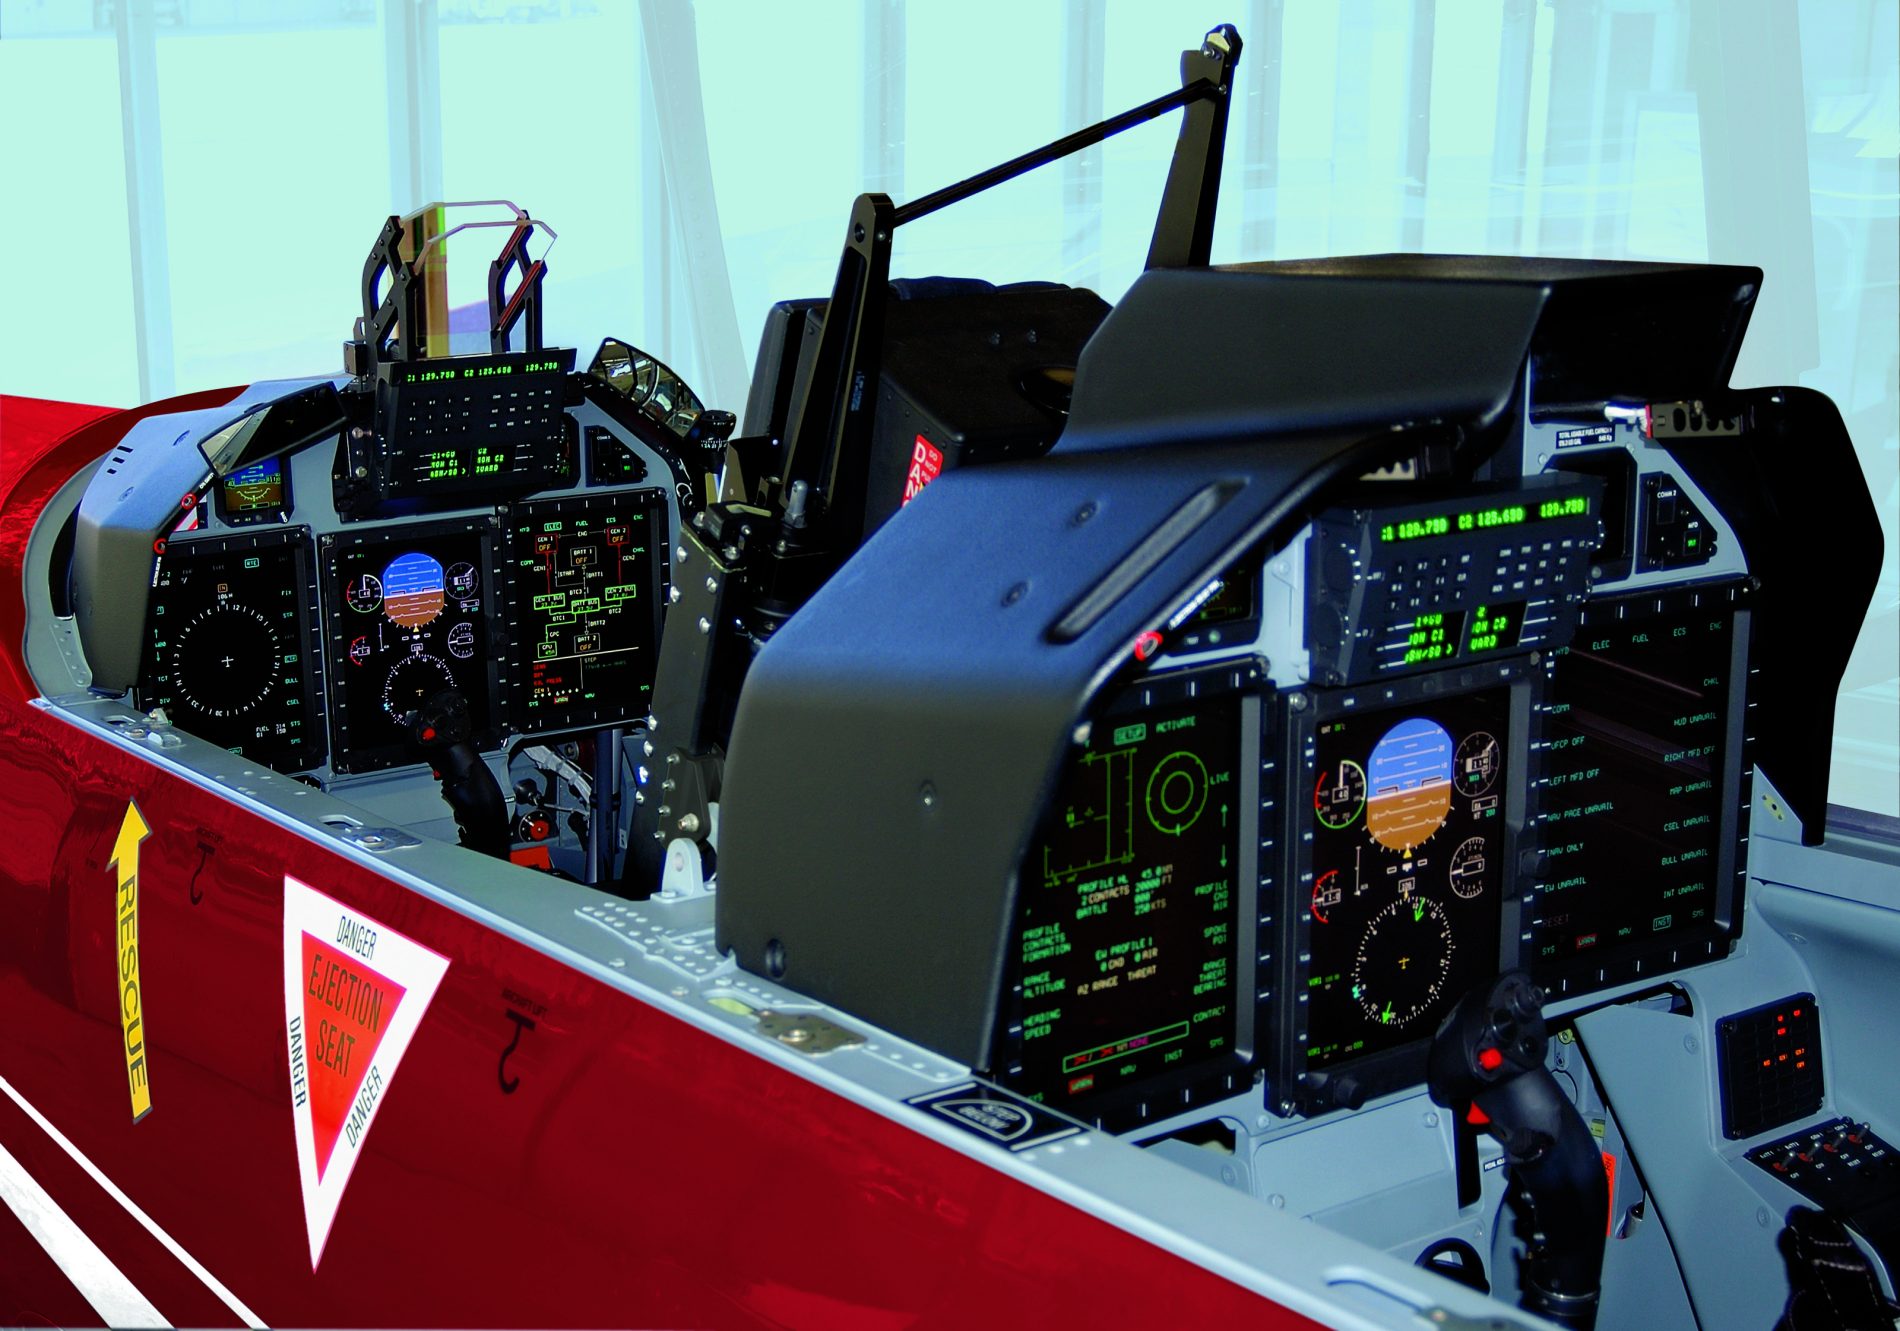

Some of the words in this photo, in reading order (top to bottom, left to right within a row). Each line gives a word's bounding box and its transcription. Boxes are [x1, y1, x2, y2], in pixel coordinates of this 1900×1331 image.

[1458, 513, 1474, 531] C2
[1592, 640, 1610, 651] ELEC
[1632, 634, 1648, 643] FUEL
[1673, 627, 1686, 637] ECS
[1552, 704, 1570, 714] COMM
[1156, 716, 1196, 733] ACTIVATE
[1690, 712, 1717, 724] UNAVAIL
[1572, 735, 1585, 745] OFF
[1664, 753, 1684, 763] RIGHT
[1687, 749, 1701, 758] MFD
[1704, 745, 1715, 754] OFF
[1210, 771, 1229, 785] LIVE
[1549, 774, 1566, 786] LEFT
[1570, 771, 1584, 782] MFD
[1587, 768, 1600, 778] OFF
[1685, 780, 1712, 793] UNAVAIL
[1564, 808, 1581, 818] PAGE
[1585, 802, 1614, 815] UNAVAIL
[1664, 822, 1680, 832] CSEL
[1683, 815, 1710, 827] UNAVAIL
[1566, 842, 1584, 853] ONLY
[1661, 856, 1678, 865] BULL
[1681, 848, 1708, 861] UNAVAIL
[1077, 877, 1114, 894] PROFILE
[1195, 879, 1228, 896] PROFILE
[1557, 877, 1587, 890] UNAVAIL
[1677, 883, 1704, 896] UNAVAIL
[1076, 902, 1107, 919] BATTLE
[1213, 900, 1228, 911] AIR
[336, 915, 378, 960] DANGER
[1022, 922, 1060, 940] PROFILE
[1110, 938, 1146, 955] PROFILE
[1142, 947, 1158, 960] AIR
[1542, 945, 1555, 956] SYS
[1203, 957, 1227, 971] RANGE
[1023, 970, 1050, 986] RANGE
[1092, 975, 1118, 991] RANGE
[1127, 964, 1157, 981] THREAT
[1199, 967, 1227, 982] THREAT
[117, 874, 147, 1096] RESCUE
[308, 953, 384, 1034] EJECTION
[1023, 978, 1066, 999] ALTITUDE
[1193, 977, 1227, 995] BEARING
[1023, 1007, 1061, 1026] HEADING
[1193, 1005, 1226, 1023] CONTACT
[1024, 1023, 1051, 1040] SPEED
[316, 1019, 356, 1078] SEAT
[1165, 1049, 1183, 1063] INST
[289, 1016, 307, 1108] DANGER
[345, 1065, 384, 1148] DANGER
